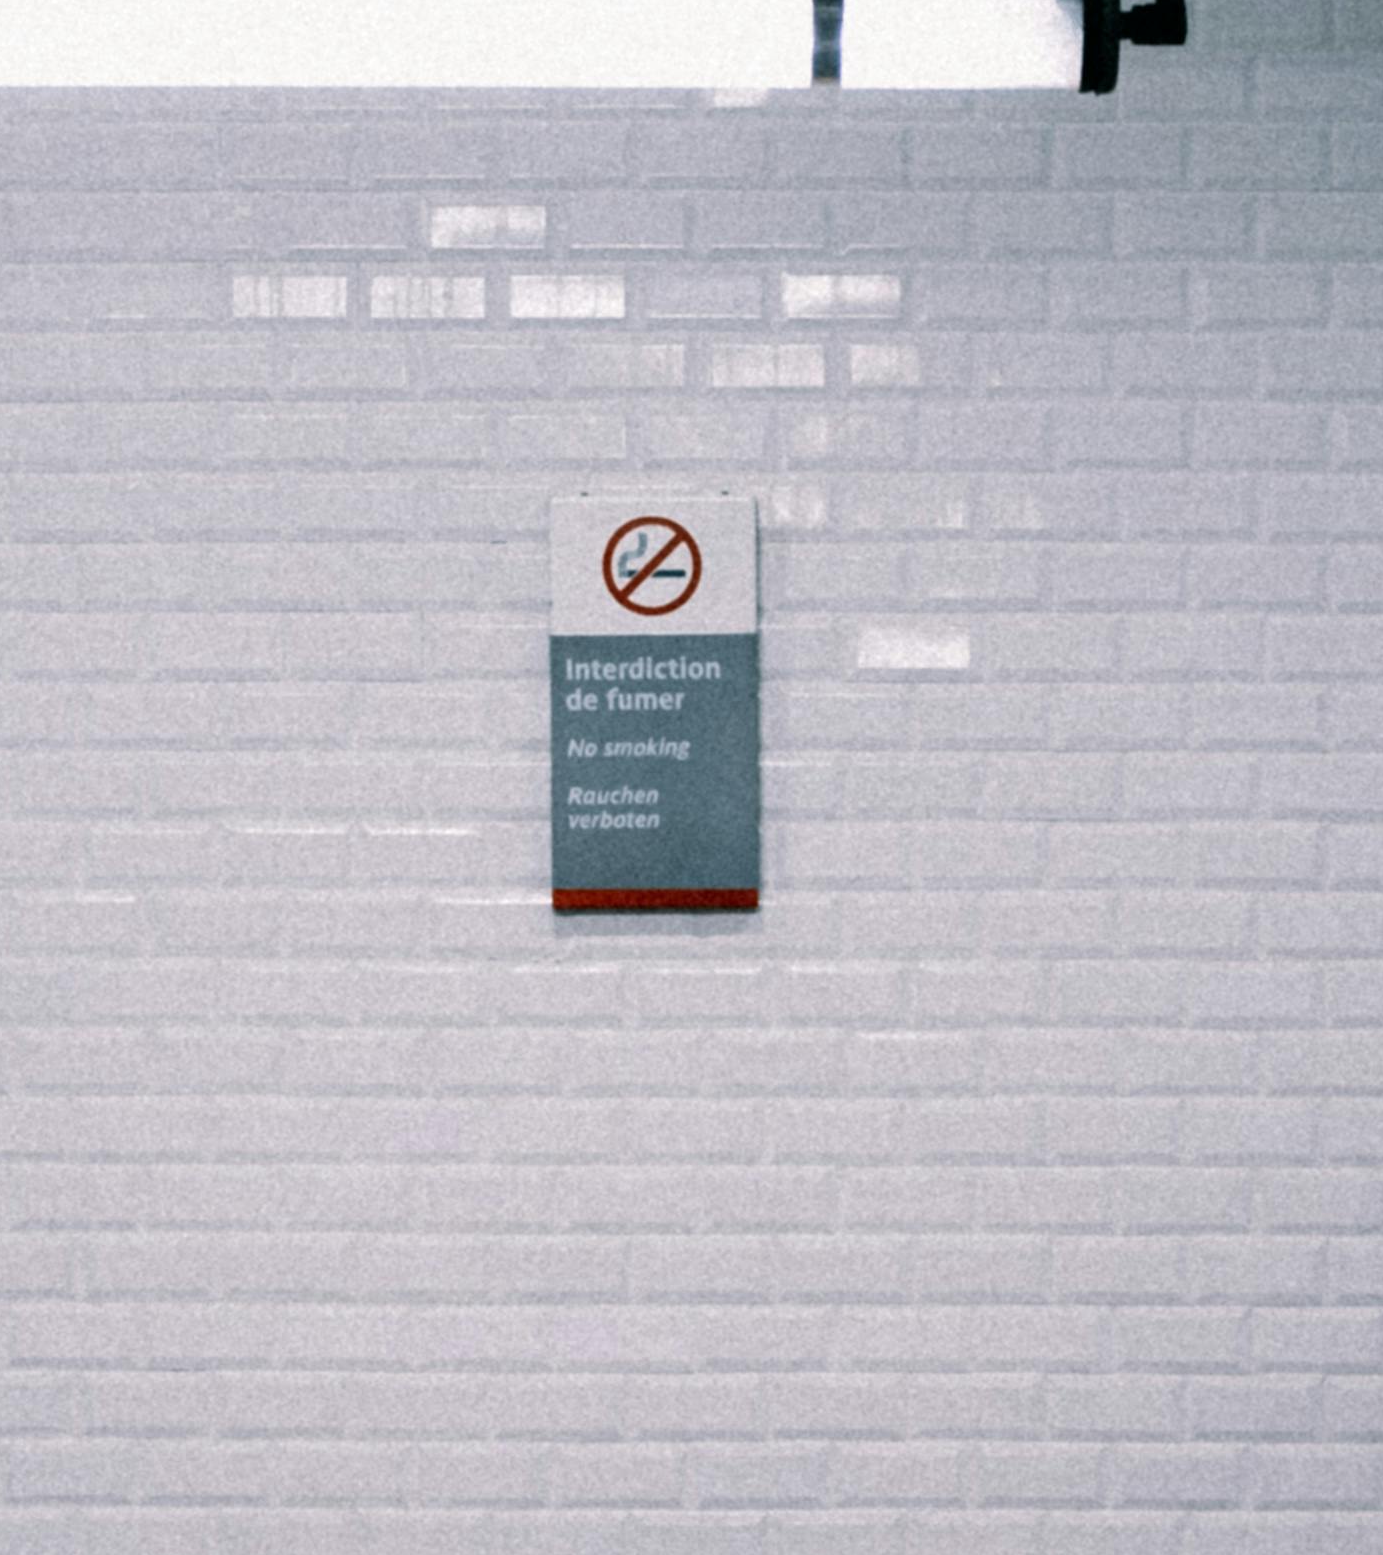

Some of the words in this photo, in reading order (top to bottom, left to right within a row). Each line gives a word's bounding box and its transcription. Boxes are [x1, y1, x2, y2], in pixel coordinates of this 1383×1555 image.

[566, 656, 721, 681] Interdiction
[566, 688, 598, 711] de
[605, 687, 684, 711] fumer
[568, 739, 597, 758] No
[603, 737, 690, 760] smoking
[568, 786, 659, 805] Rauchen
[568, 811, 660, 830] verboten
